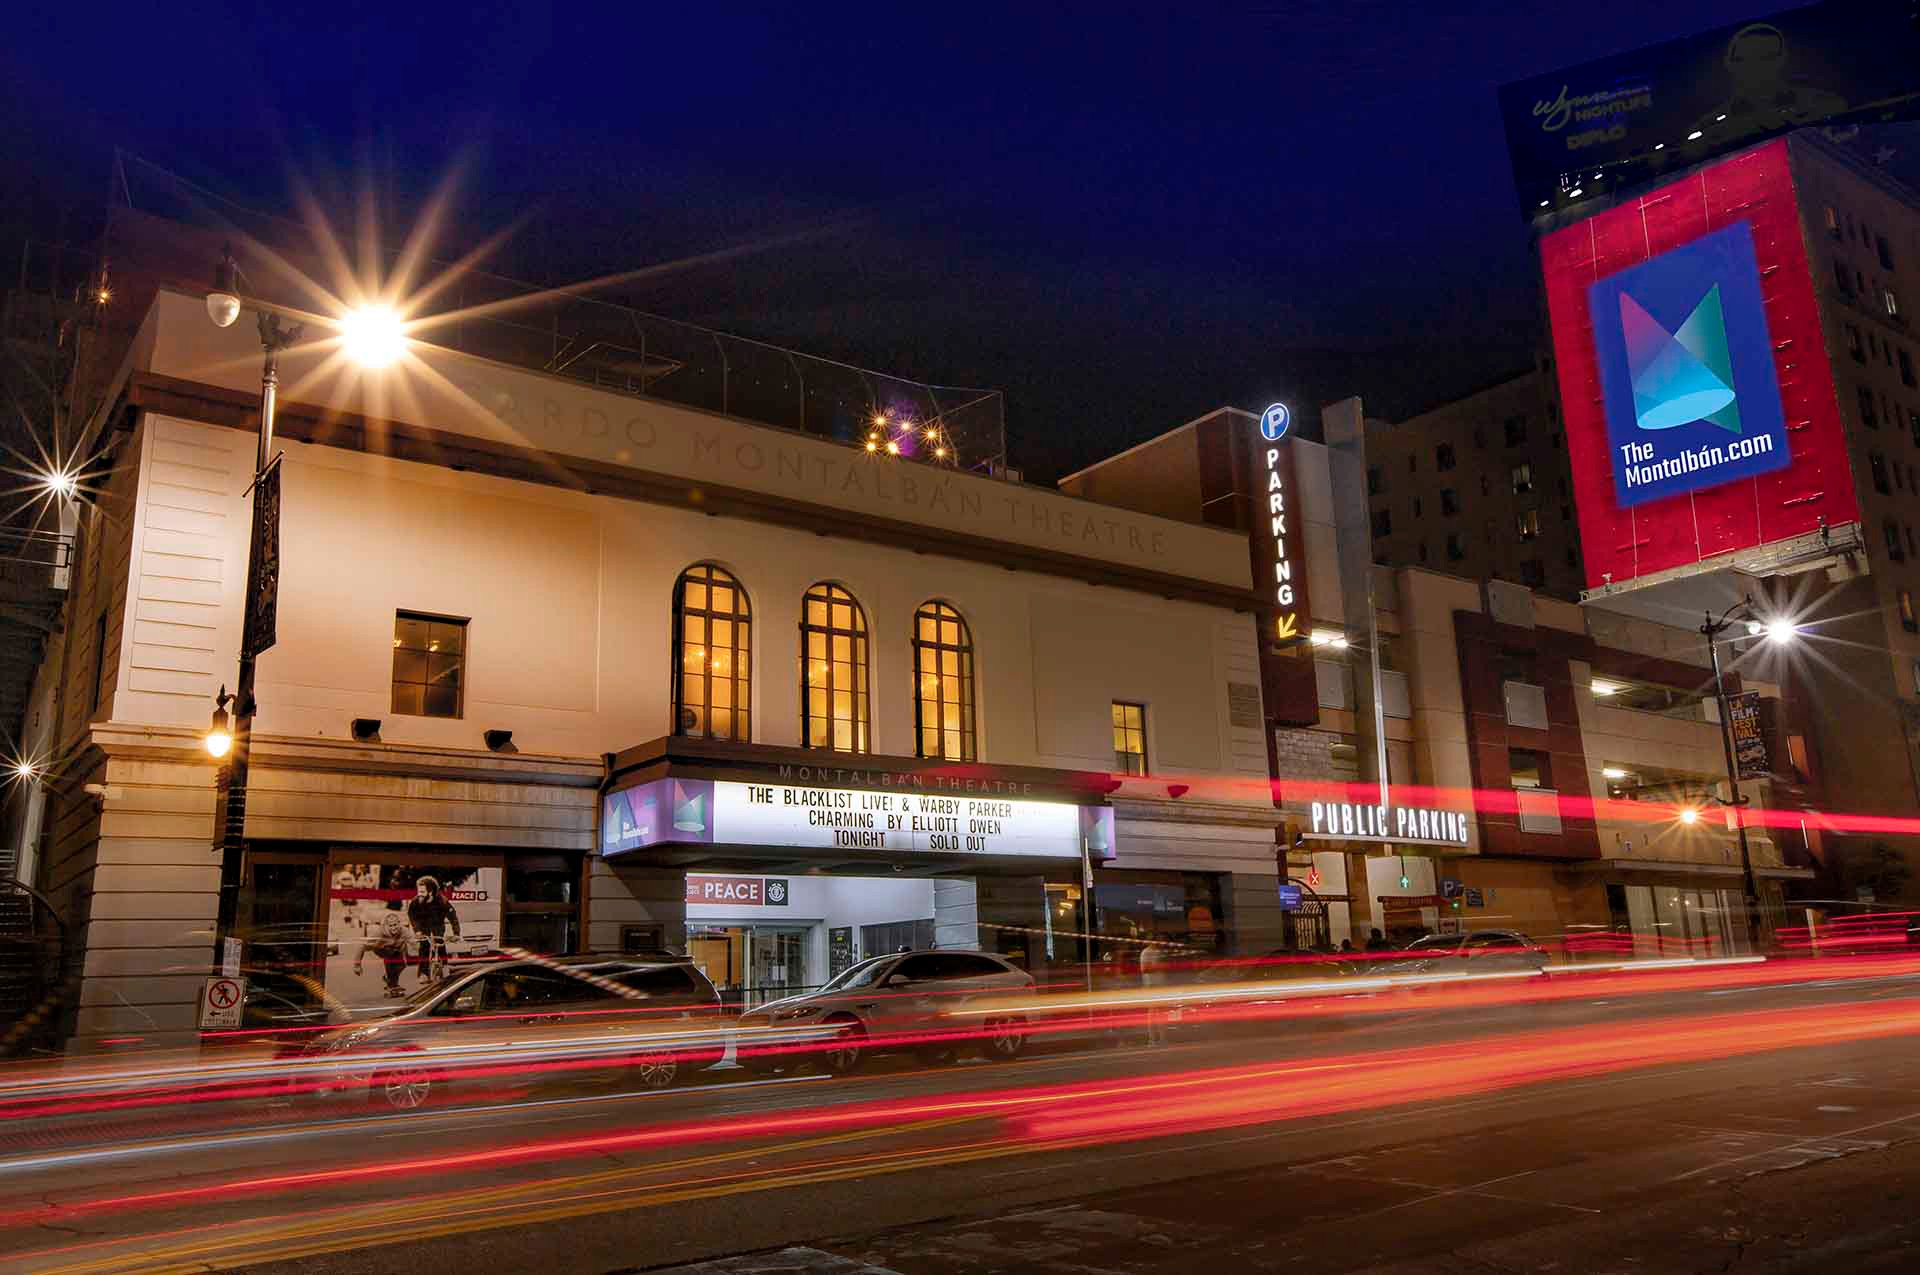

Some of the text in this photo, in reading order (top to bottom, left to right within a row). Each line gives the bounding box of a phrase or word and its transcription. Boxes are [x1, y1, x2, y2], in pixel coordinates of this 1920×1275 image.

[1267, 407, 1285, 438] P
[1620, 442, 1655, 465] The
[1624, 433, 1774, 488] Montalbán.com
[1003, 498, 1169, 555] THEATRE
[1266, 449, 1294, 605] PARKING
[1731, 706, 1754, 721] FILM
[935, 776, 1032, 794] THEATRE
[748, 787, 1012, 818] THE BLACKLIST LIVE! & WARBY PARKER
[809, 810, 1001, 835] CHARMING BY ELLIOTT OWEN
[1312, 802, 1468, 843] PUBLIC PARKING
[834, 830, 986, 851] TONIGHT SOLD OUT
[451, 891, 475, 900] PEACE
[704, 882, 759, 900] PEACE
